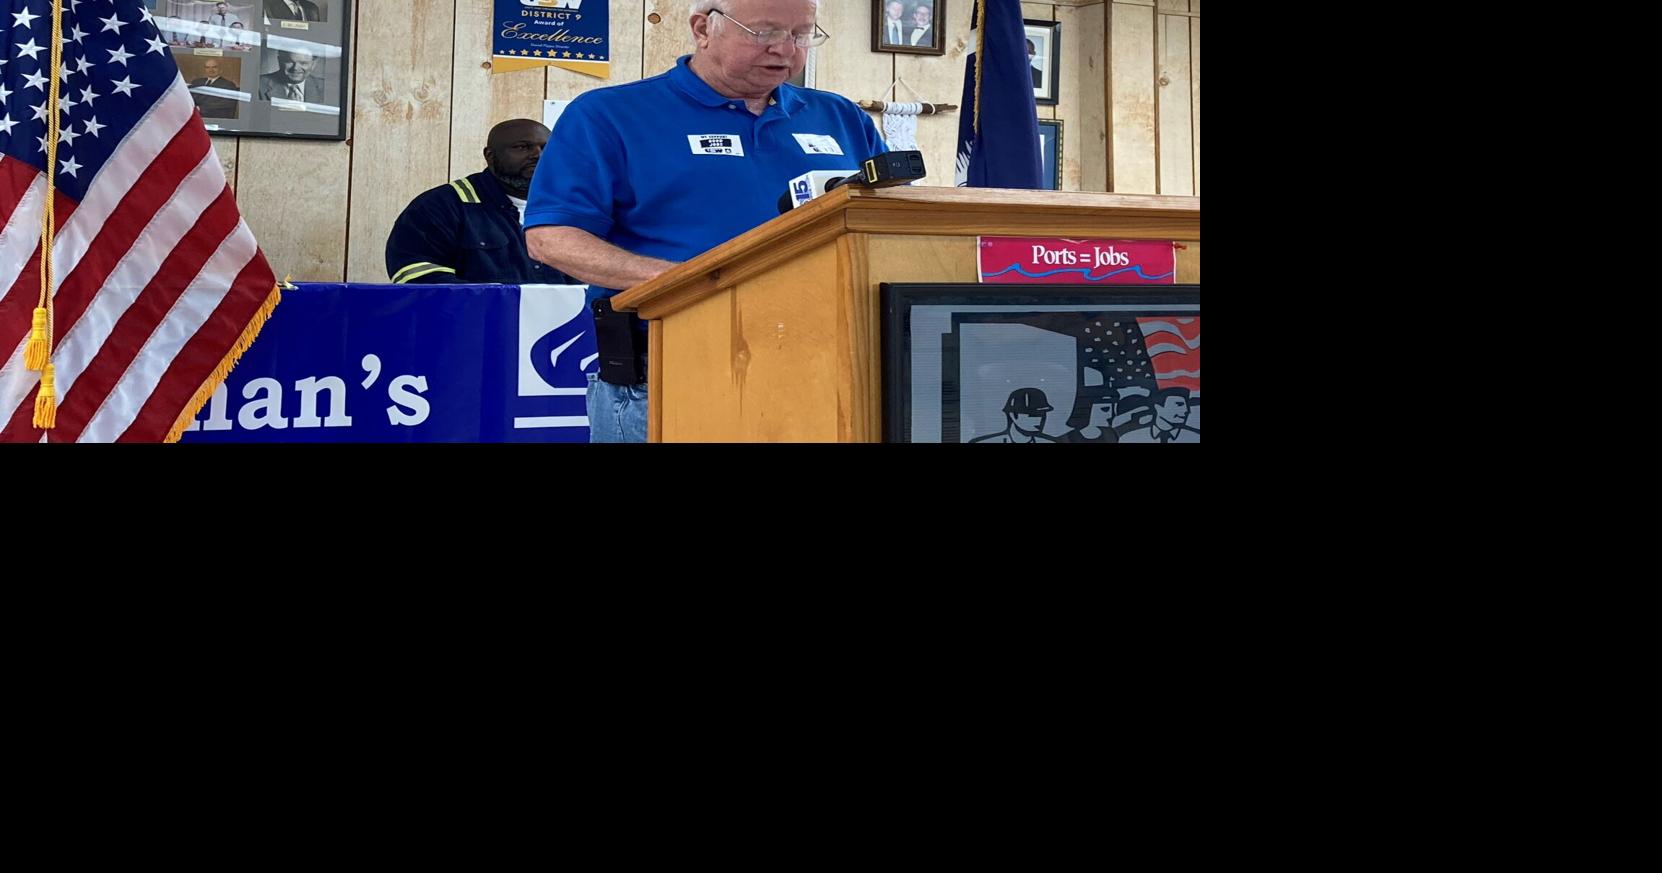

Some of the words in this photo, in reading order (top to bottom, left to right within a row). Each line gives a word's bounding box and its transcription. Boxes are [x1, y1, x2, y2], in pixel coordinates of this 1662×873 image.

[521, 10, 571, 20] DISTRICT
[501, 21, 603, 44] Excellence
[793, 180, 810, 201] 15
[1032, 245, 1076, 265] Ports
[1080, 252, 1090, 262] =
[1093, 246, 1130, 268] Jobs
